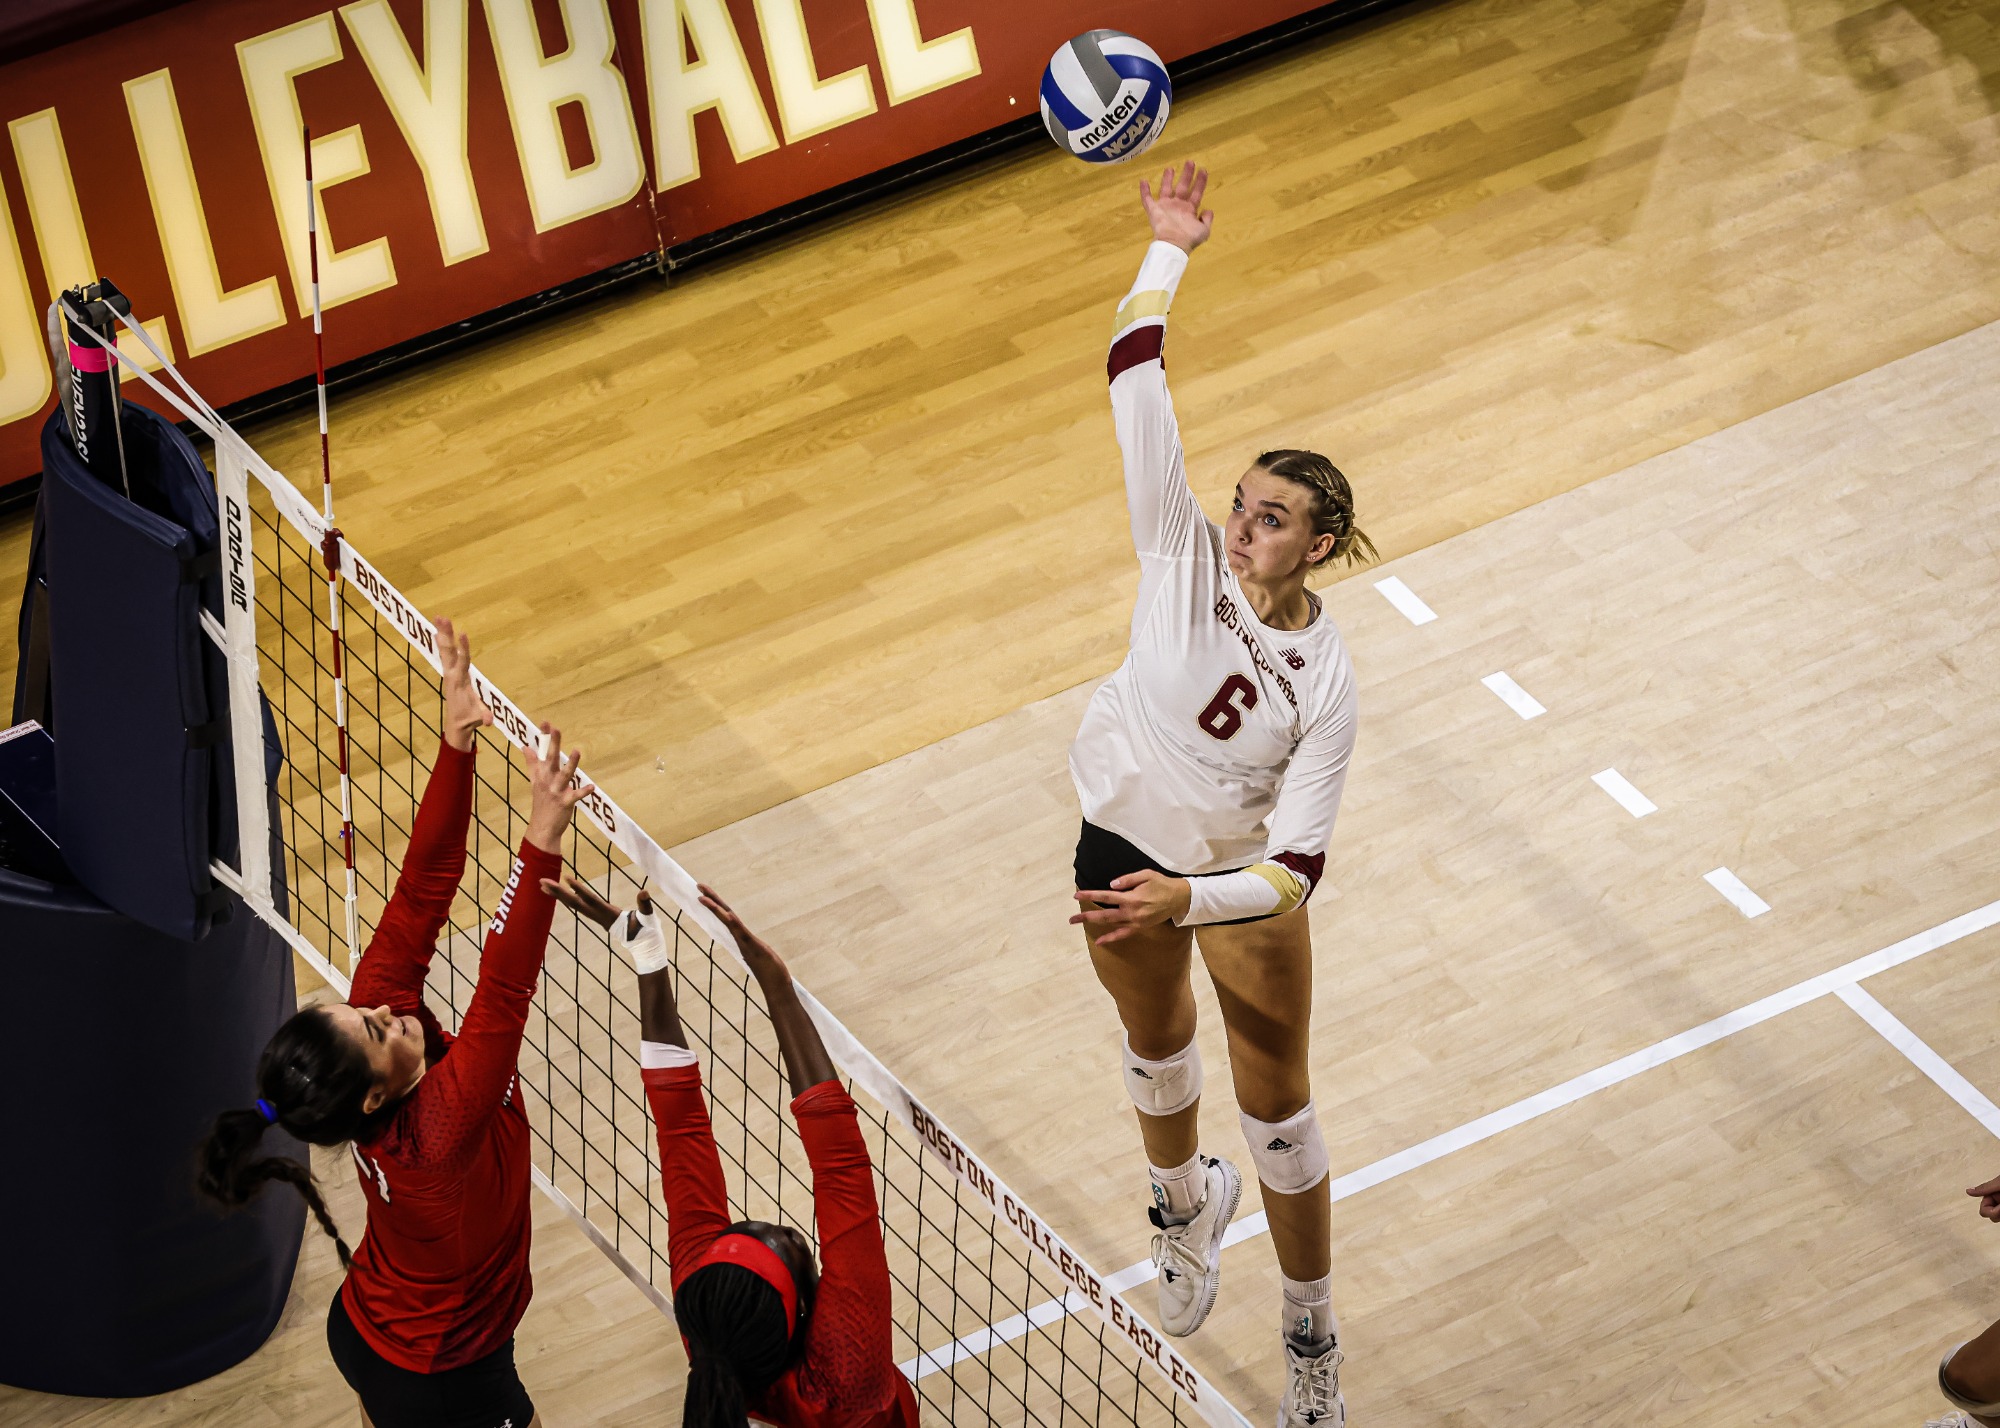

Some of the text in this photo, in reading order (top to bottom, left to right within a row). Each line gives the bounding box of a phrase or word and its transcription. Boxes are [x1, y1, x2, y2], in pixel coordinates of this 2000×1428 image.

[1079, 93, 1138, 148] molten
[1102, 112, 1152, 159] NCAA
[226, 495, 247, 613] PORTER
[354, 558, 433, 654] BOSTON
[1214, 594, 1254, 646] BOS
[1196, 671, 1259, 742] 6
[490, 857, 525, 934] HAWKS
[910, 1101, 1198, 1402] BOSTON COLLEGE EAGLES
